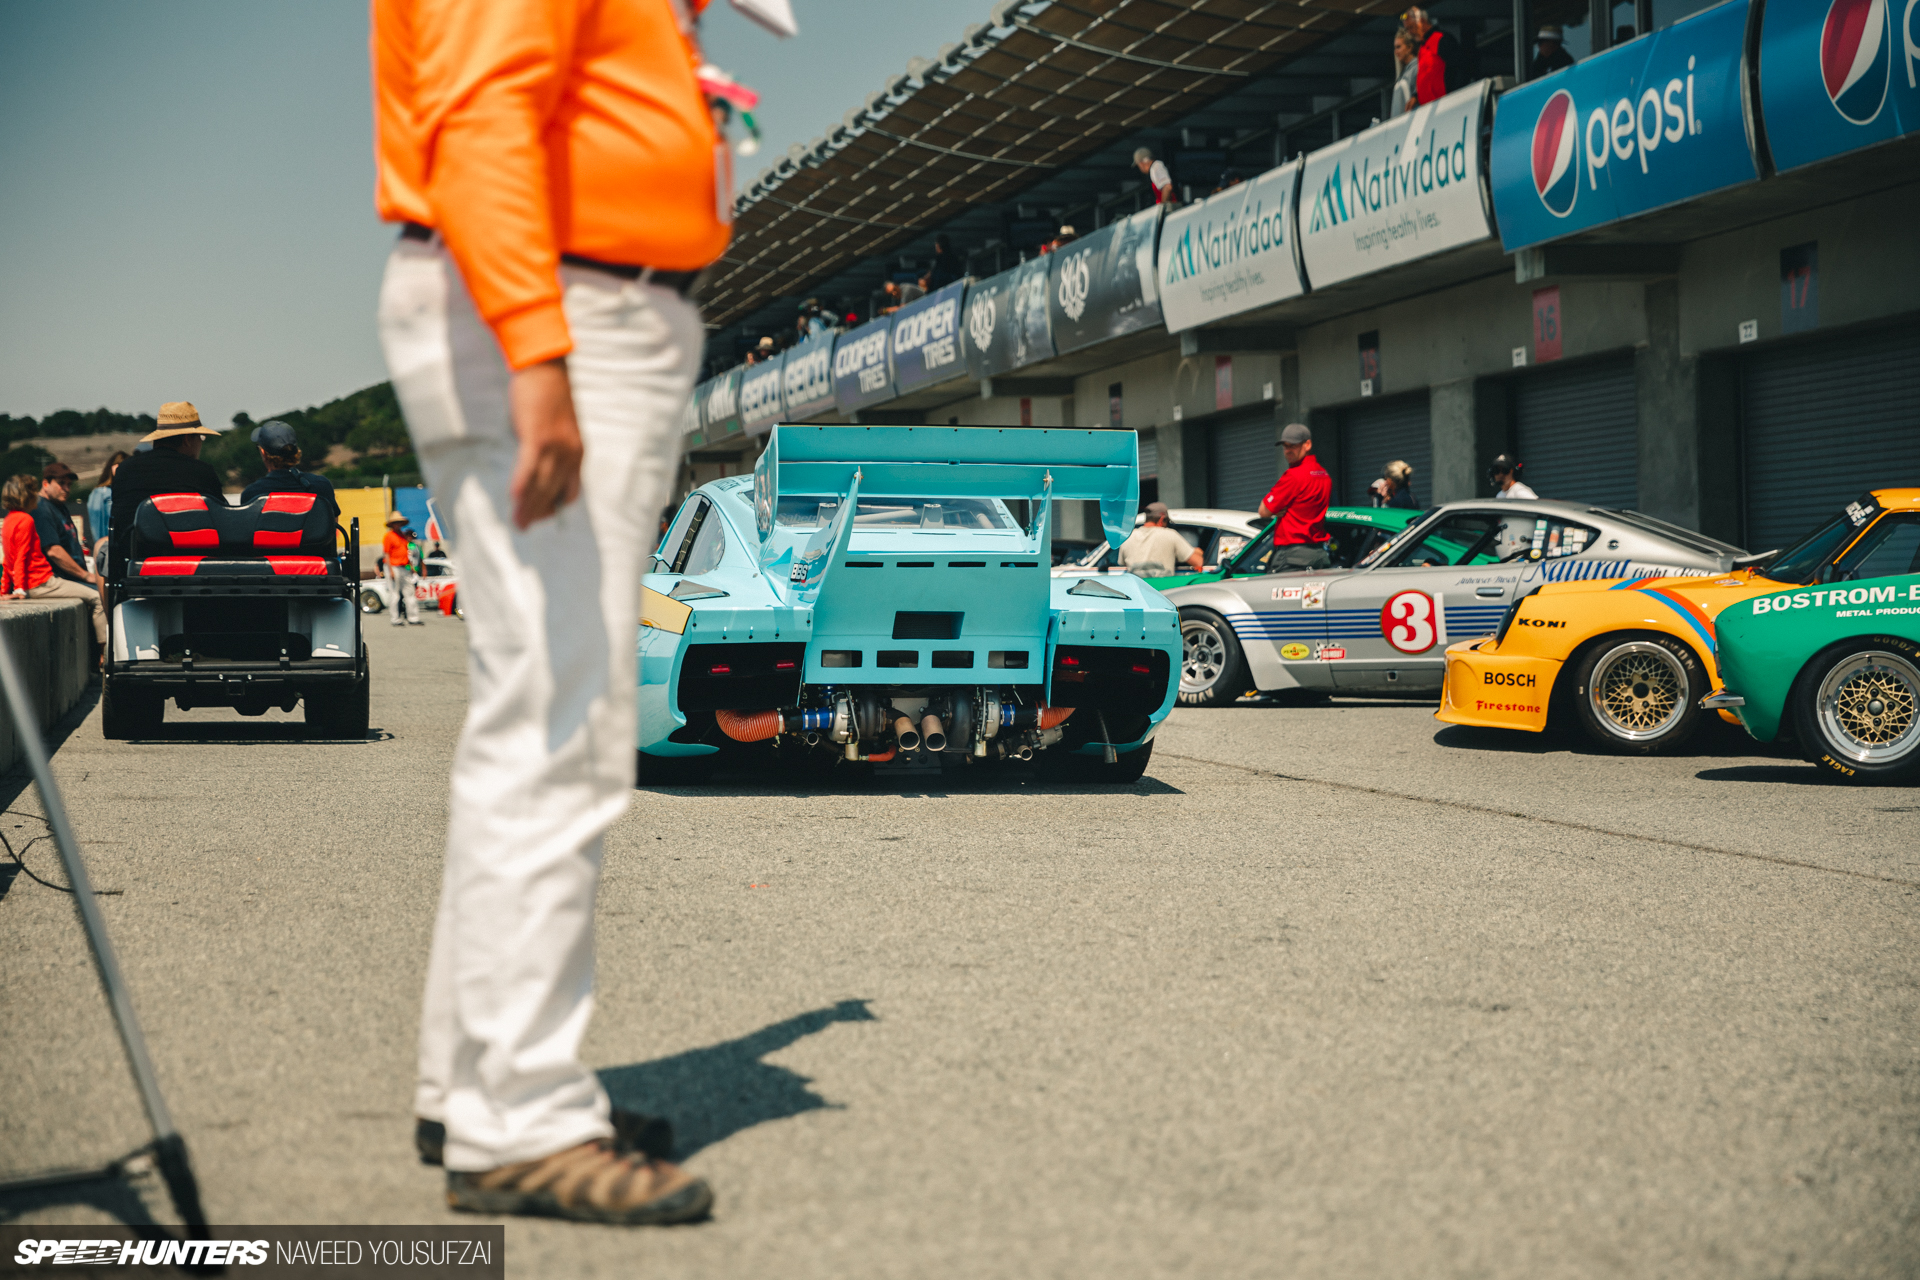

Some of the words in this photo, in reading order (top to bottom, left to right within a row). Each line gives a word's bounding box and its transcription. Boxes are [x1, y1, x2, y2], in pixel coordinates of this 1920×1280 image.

[1586, 54, 1696, 191] pepsi
[1351, 115, 1467, 219] Natividad
[1197, 190, 1285, 274] Natividad
[1353, 227, 1390, 255] Inspiring
[1386, 213, 1418, 239] healthy
[1787, 266, 1811, 309] 17
[895, 298, 956, 355] COOPER
[1538, 305, 1557, 342] 16
[835, 328, 887, 379] COOPER
[922, 335, 956, 370] TIRES
[741, 368, 780, 425] GEICO
[784, 346, 829, 409] GEICO
[858, 362, 886, 394] TIRES
[1523, 559, 1632, 583] Natural
[1518, 618, 1567, 628] KONI
[1836, 609, 1873, 618] METAL
[1484, 672, 1536, 687] BOSCH
[1476, 700, 1541, 713] Firestone
[1821, 754, 1856, 776] EAGLE
